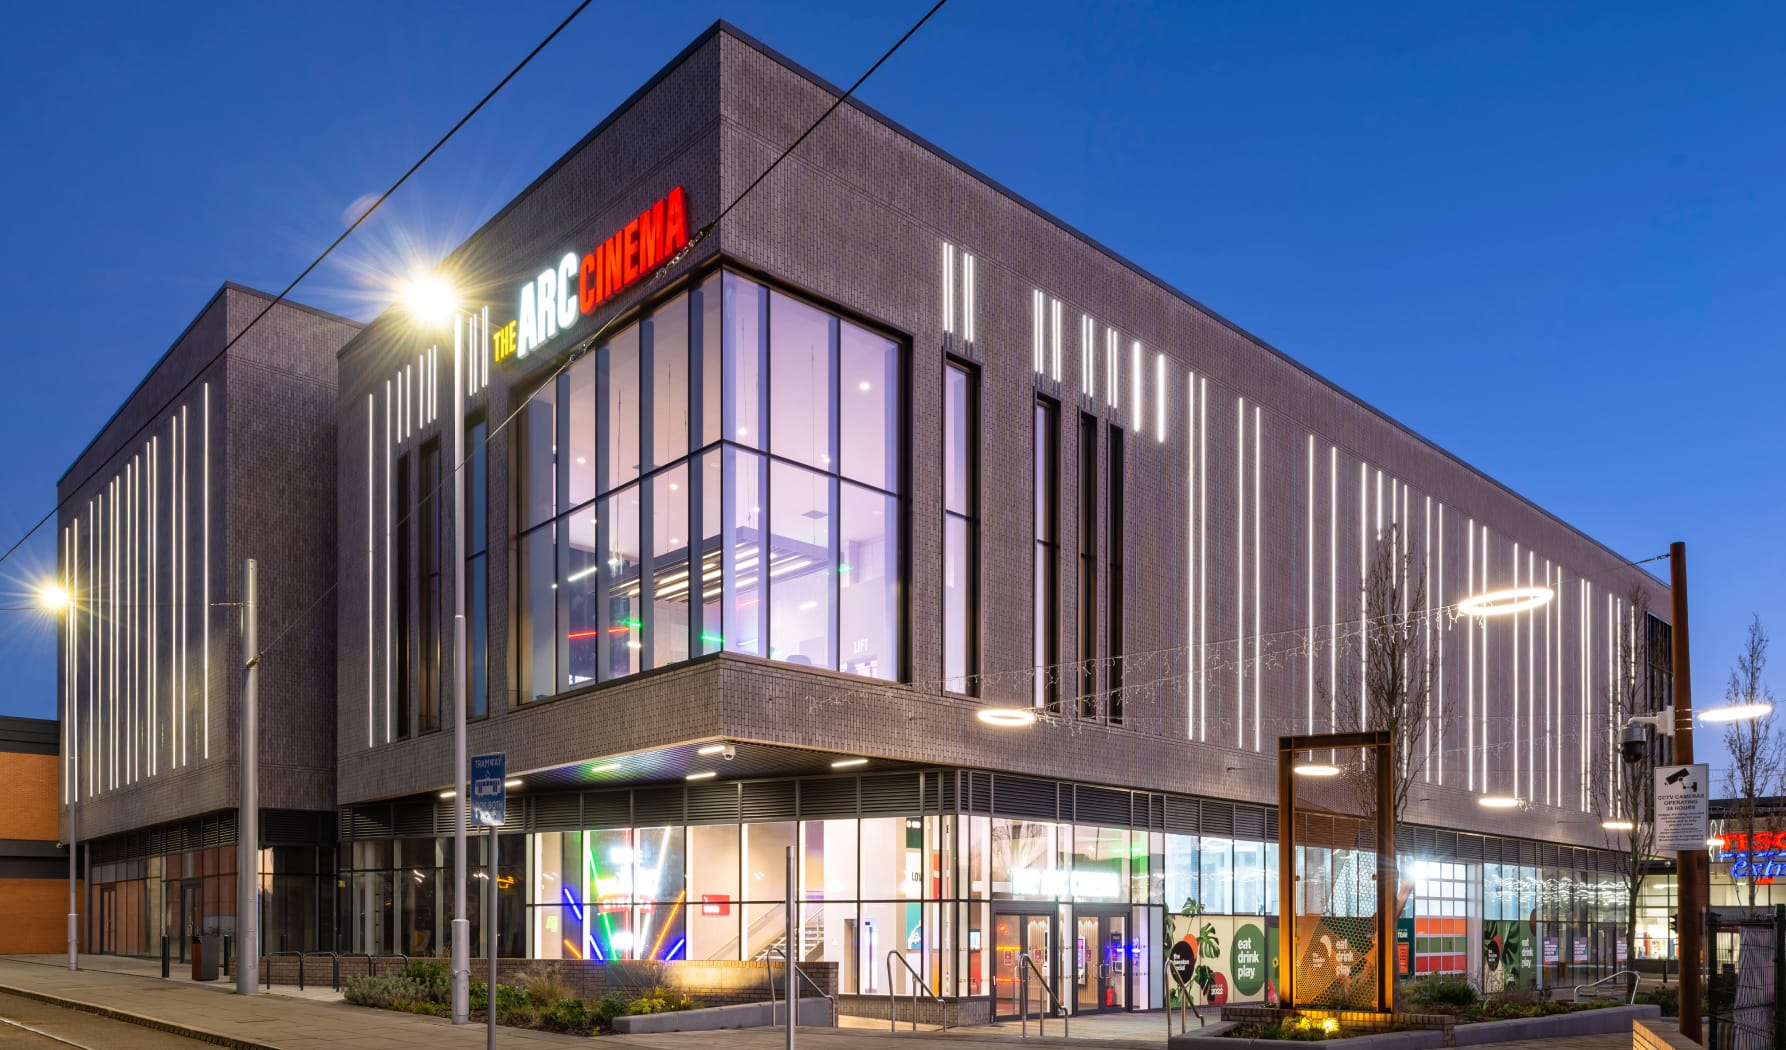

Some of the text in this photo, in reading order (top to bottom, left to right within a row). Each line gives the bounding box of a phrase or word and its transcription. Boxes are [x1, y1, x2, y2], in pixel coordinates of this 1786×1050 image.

[493, 185, 690, 363] THE ARC CINEMA
[474, 758, 501, 769] TRAMWAY
[1237, 937, 1252, 950] eat
[1336, 939, 1348, 950] eat
[1336, 950, 1354, 962] drink
